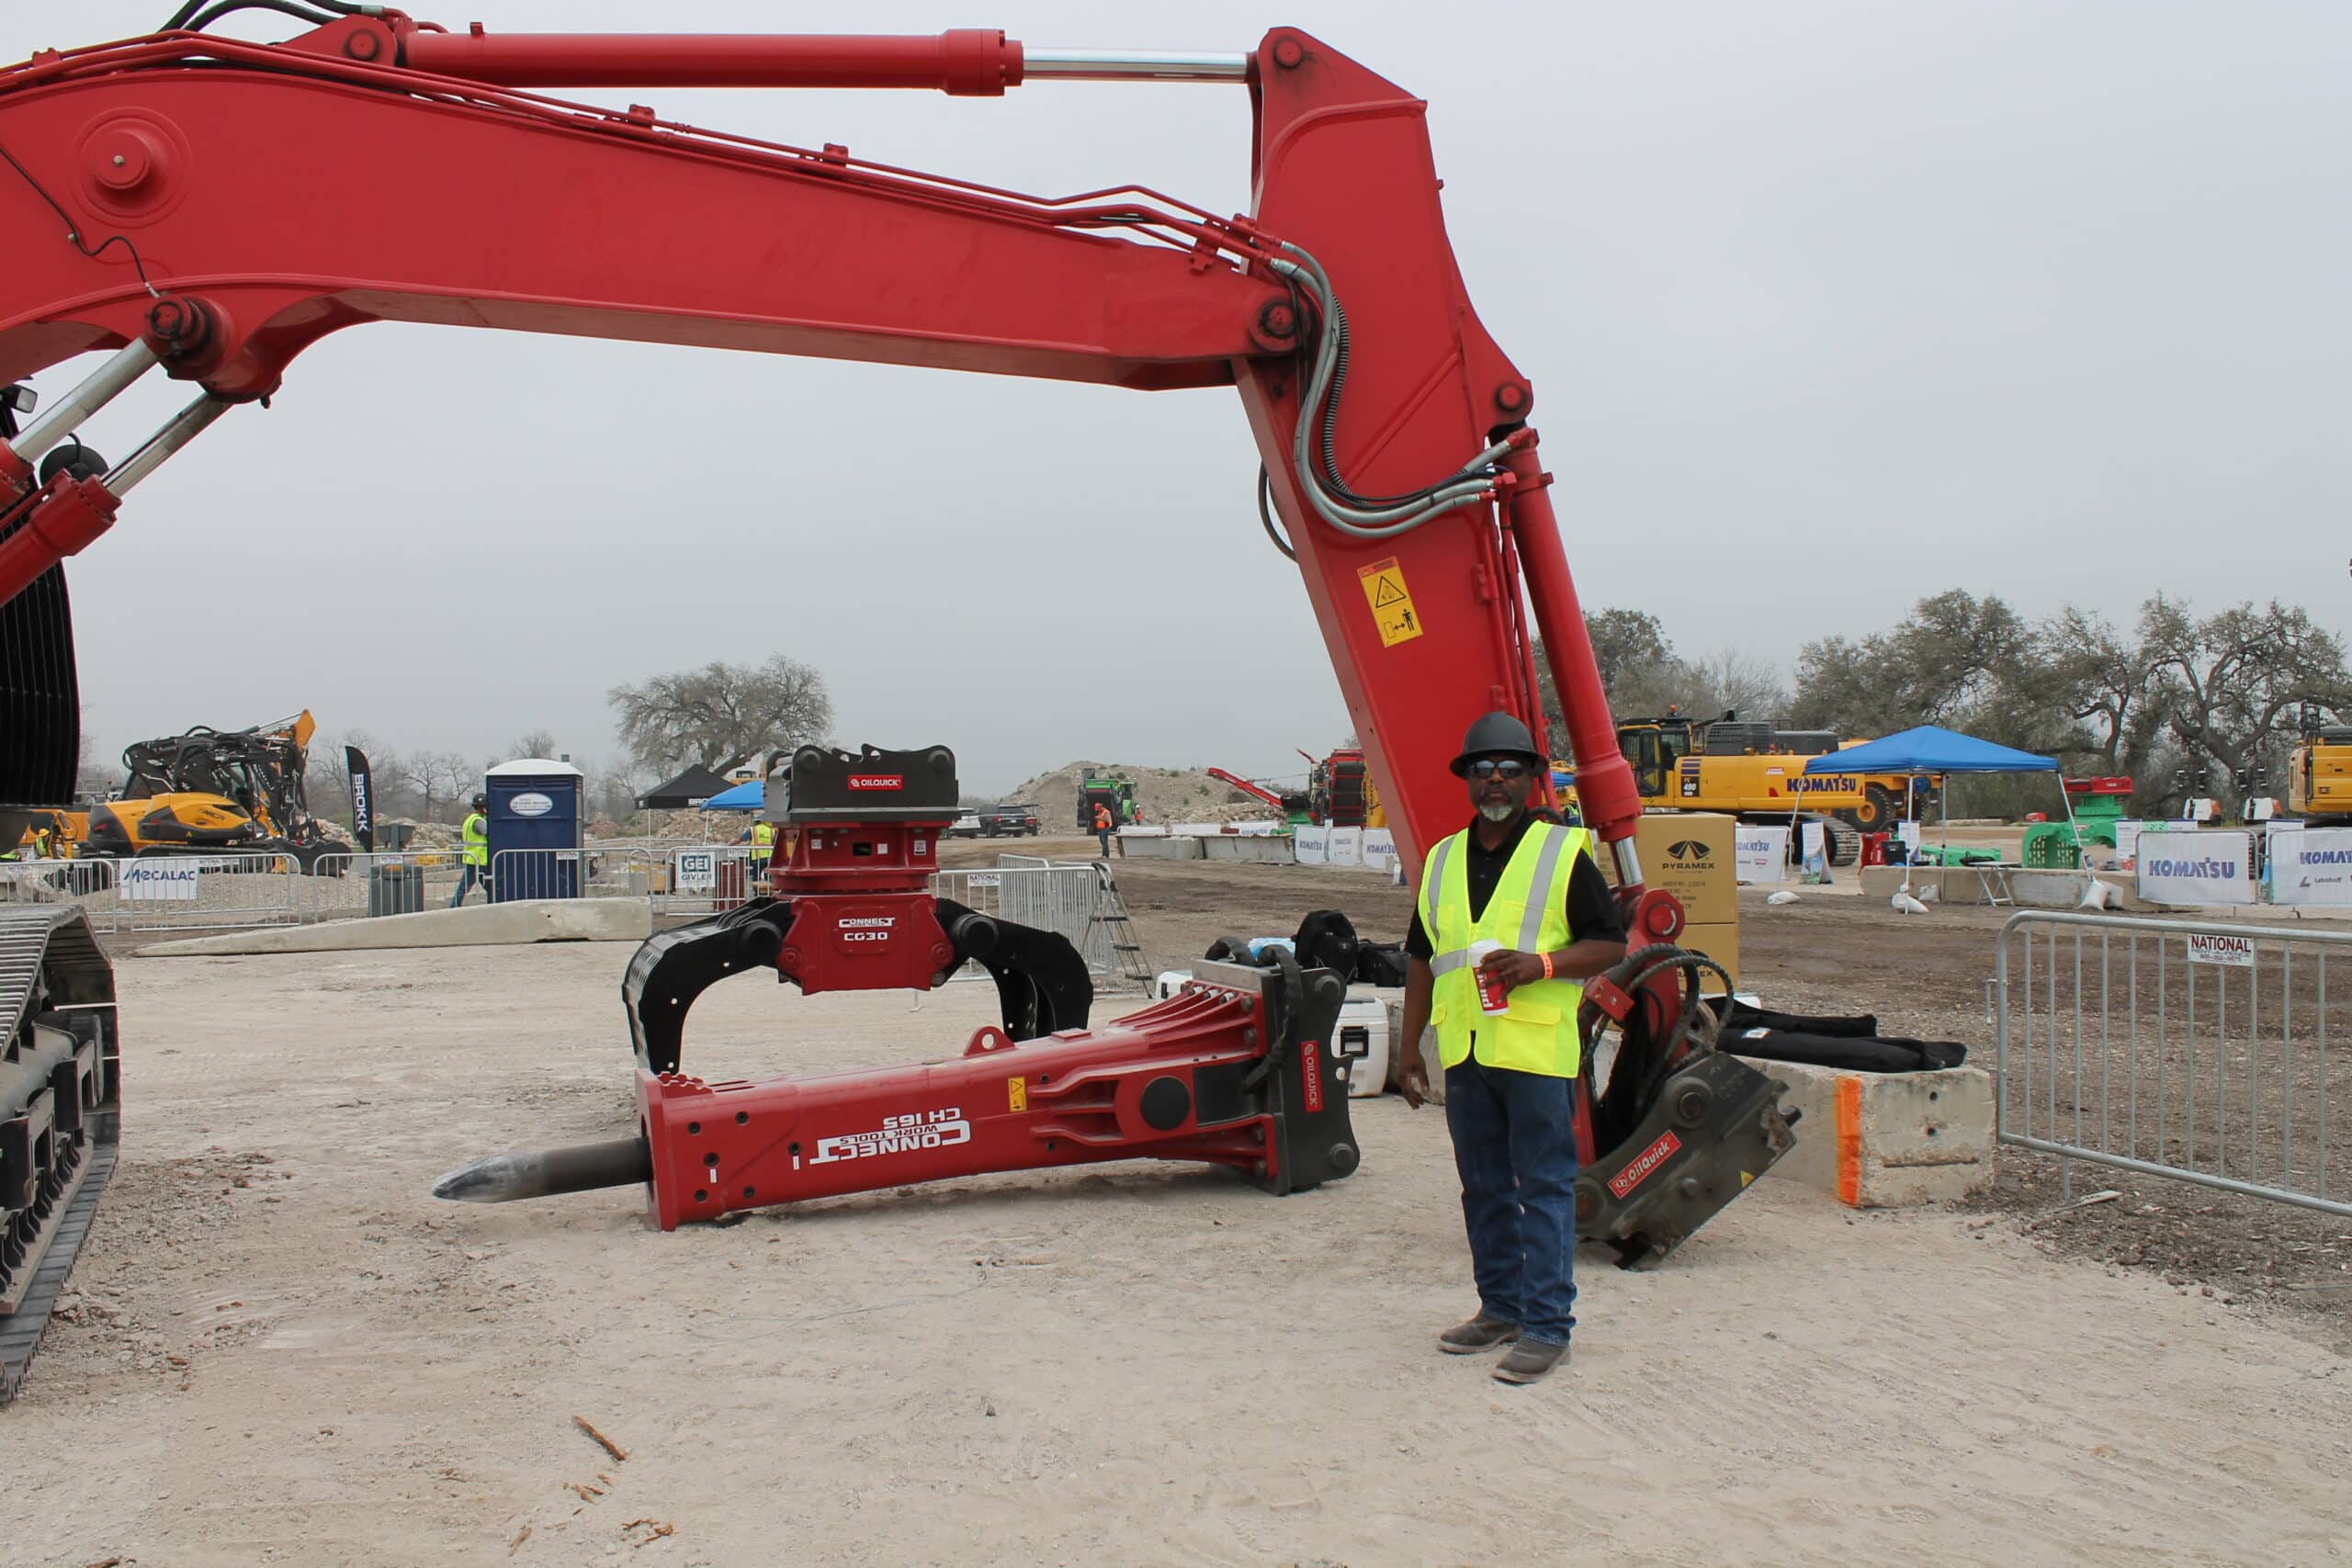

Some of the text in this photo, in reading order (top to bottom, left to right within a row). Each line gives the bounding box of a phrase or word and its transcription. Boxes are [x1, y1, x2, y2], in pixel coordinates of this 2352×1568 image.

[861, 778, 899, 786] OILQUICK
[1787, 778, 1856, 792] KOMATSU
[353, 773, 368, 832] BROKK
[1299, 839, 1322, 851] KOMATSU
[1366, 841, 1396, 853] KOMATSU
[2149, 858, 2234, 878] KOMATSU
[839, 917, 896, 928] CONNECT
[843, 931, 888, 942] CG30
[2191, 935, 2251, 953] NATIONAL
[1306, 1056, 1317, 1107] OILQUICK
[883, 1108, 961, 1130] CH 165
[809, 1120, 970, 1165] CONNECT
[840, 1124, 938, 1145] WORK TOOLS
[1628, 1141, 1670, 1181] OilQuick
